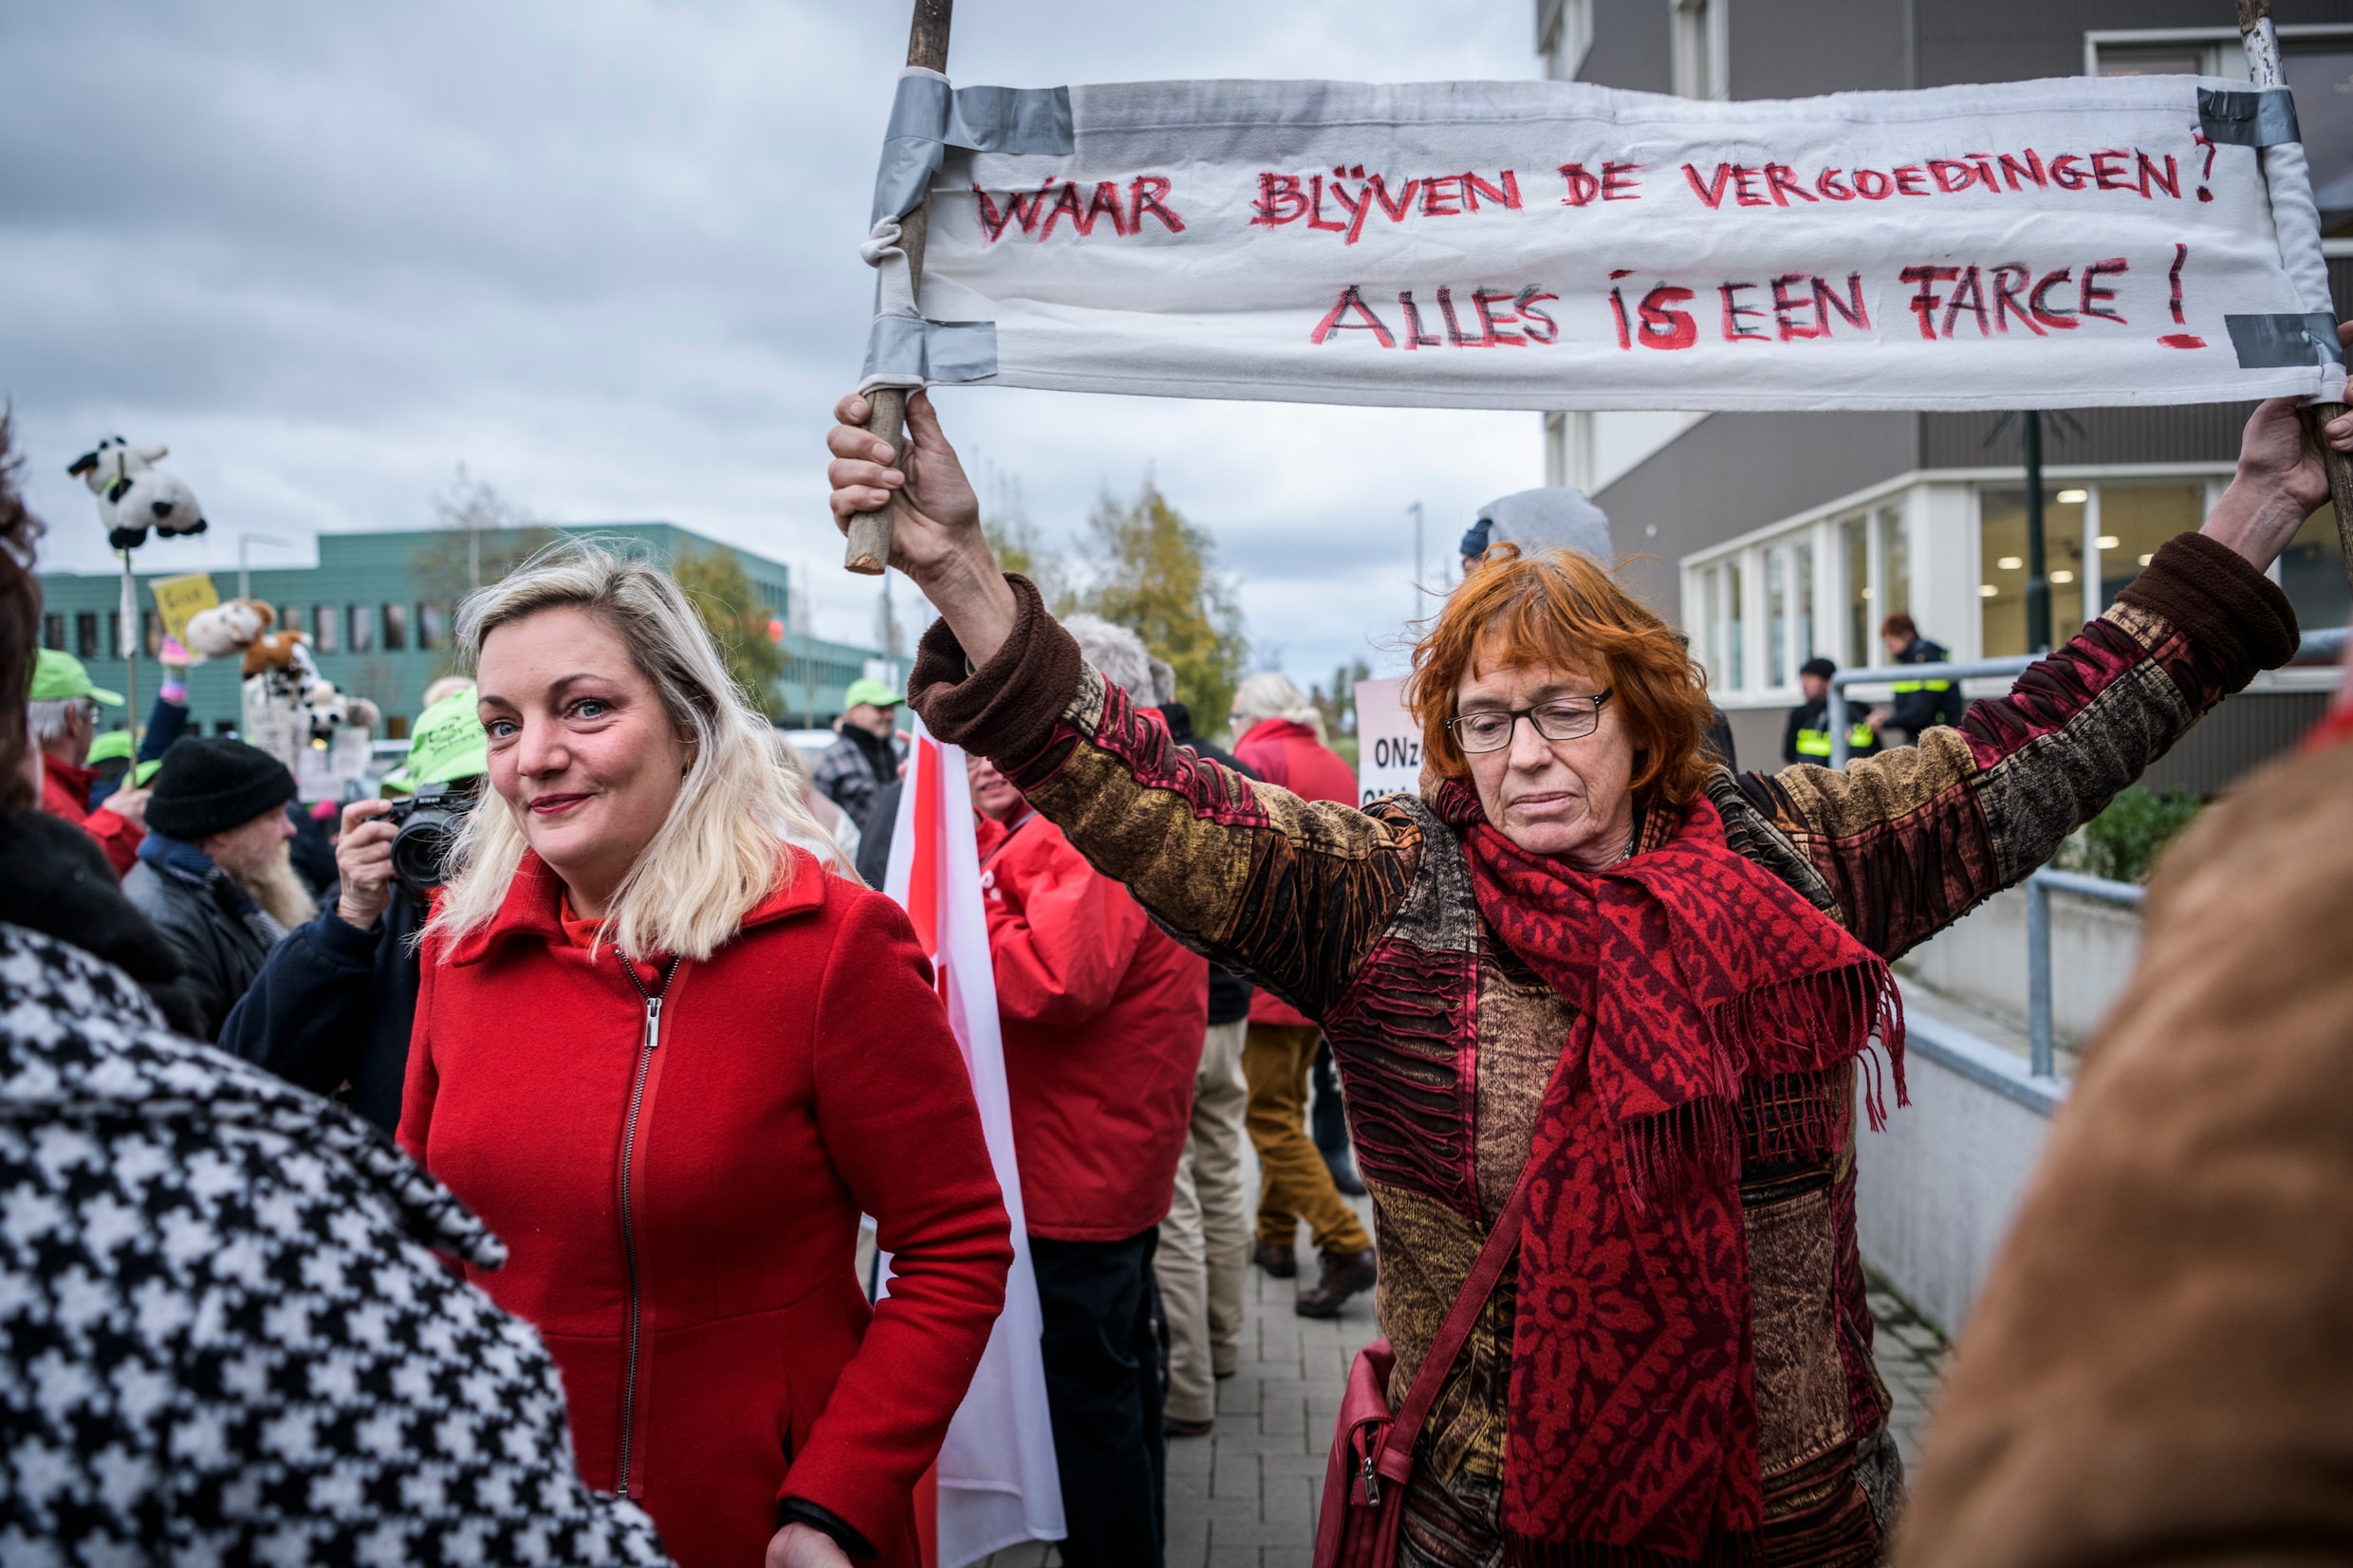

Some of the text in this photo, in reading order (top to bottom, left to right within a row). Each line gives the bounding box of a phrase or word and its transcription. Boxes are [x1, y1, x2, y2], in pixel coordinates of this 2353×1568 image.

[971, 175, 1185, 244] WAAR
[1557, 161, 1642, 208] DE
[1311, 285, 1559, 351] ALLES
[1717, 273, 1872, 343] EEN
